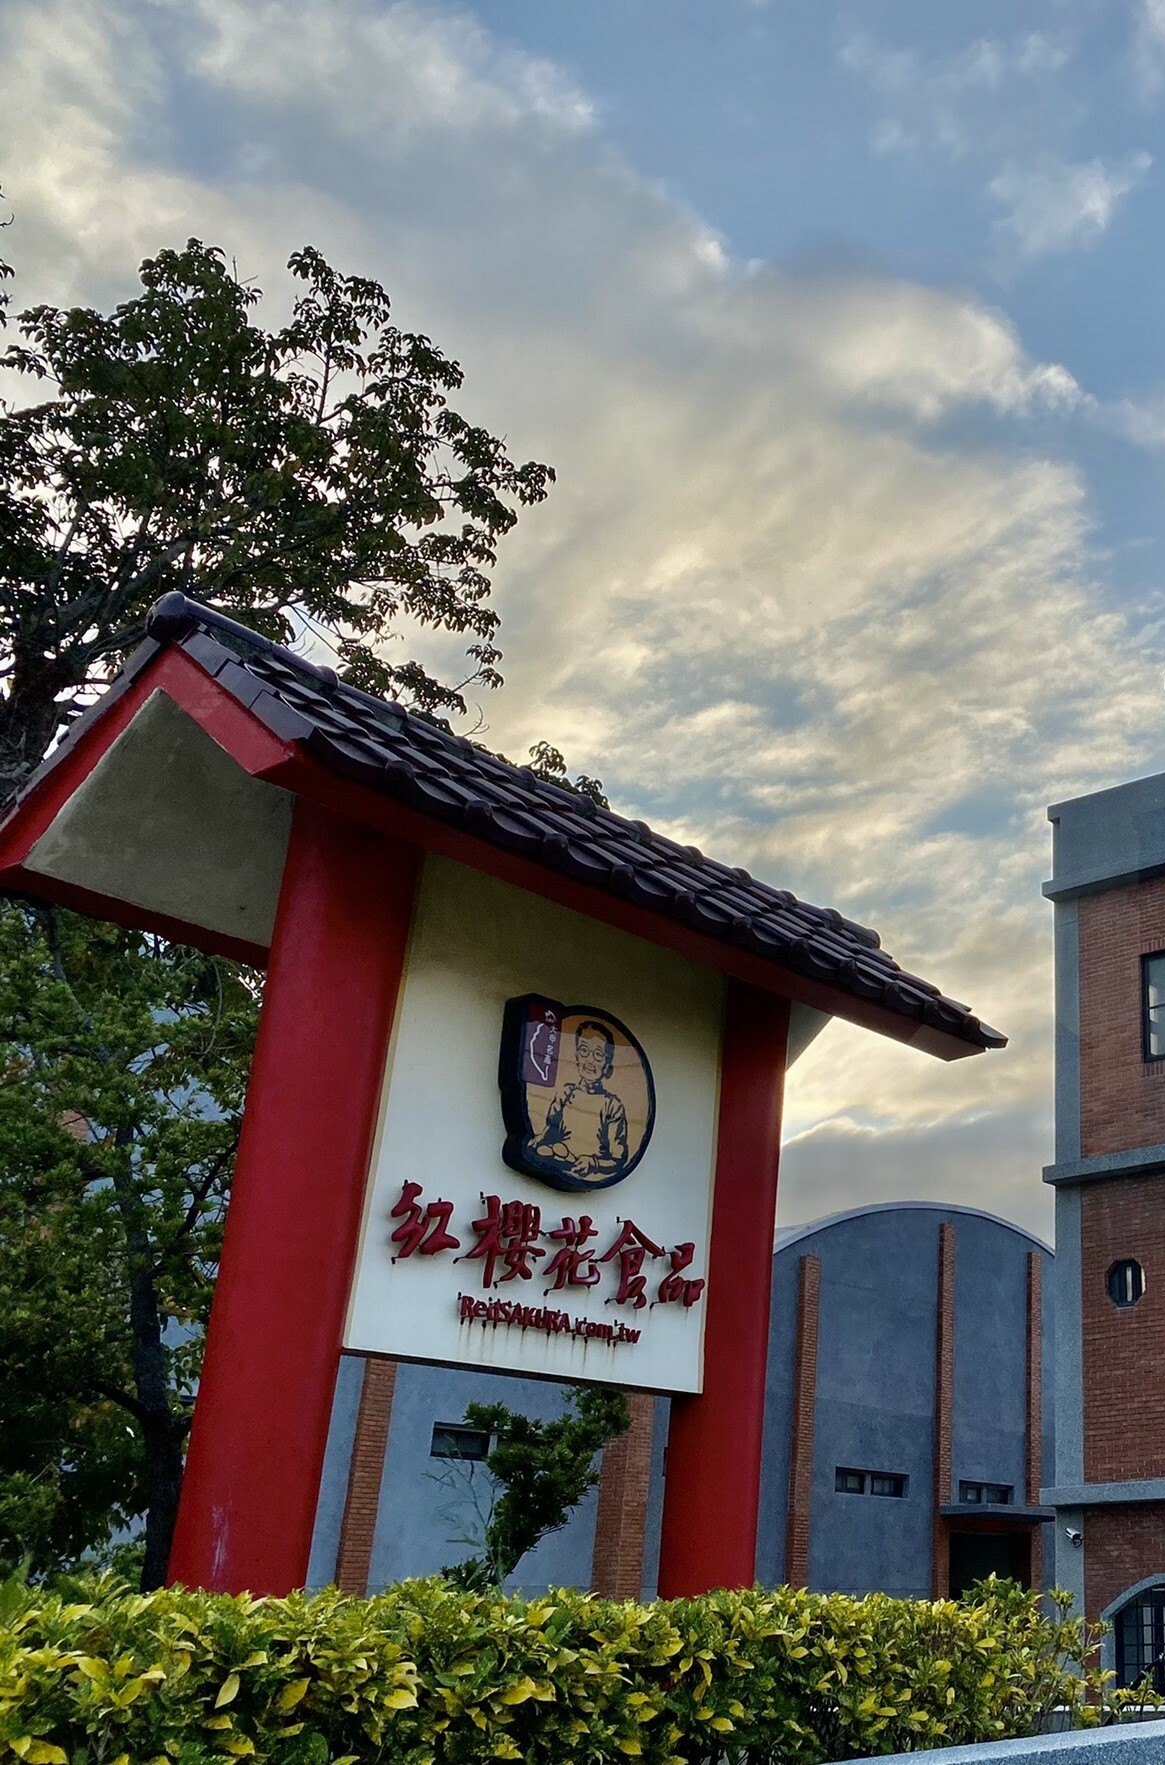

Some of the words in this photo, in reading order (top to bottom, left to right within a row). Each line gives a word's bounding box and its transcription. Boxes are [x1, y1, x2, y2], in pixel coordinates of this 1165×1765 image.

[391, 1181, 705, 1310] 紅櫻花食品
[460, 1295, 642, 1344] RedSAKURA.com.tw
